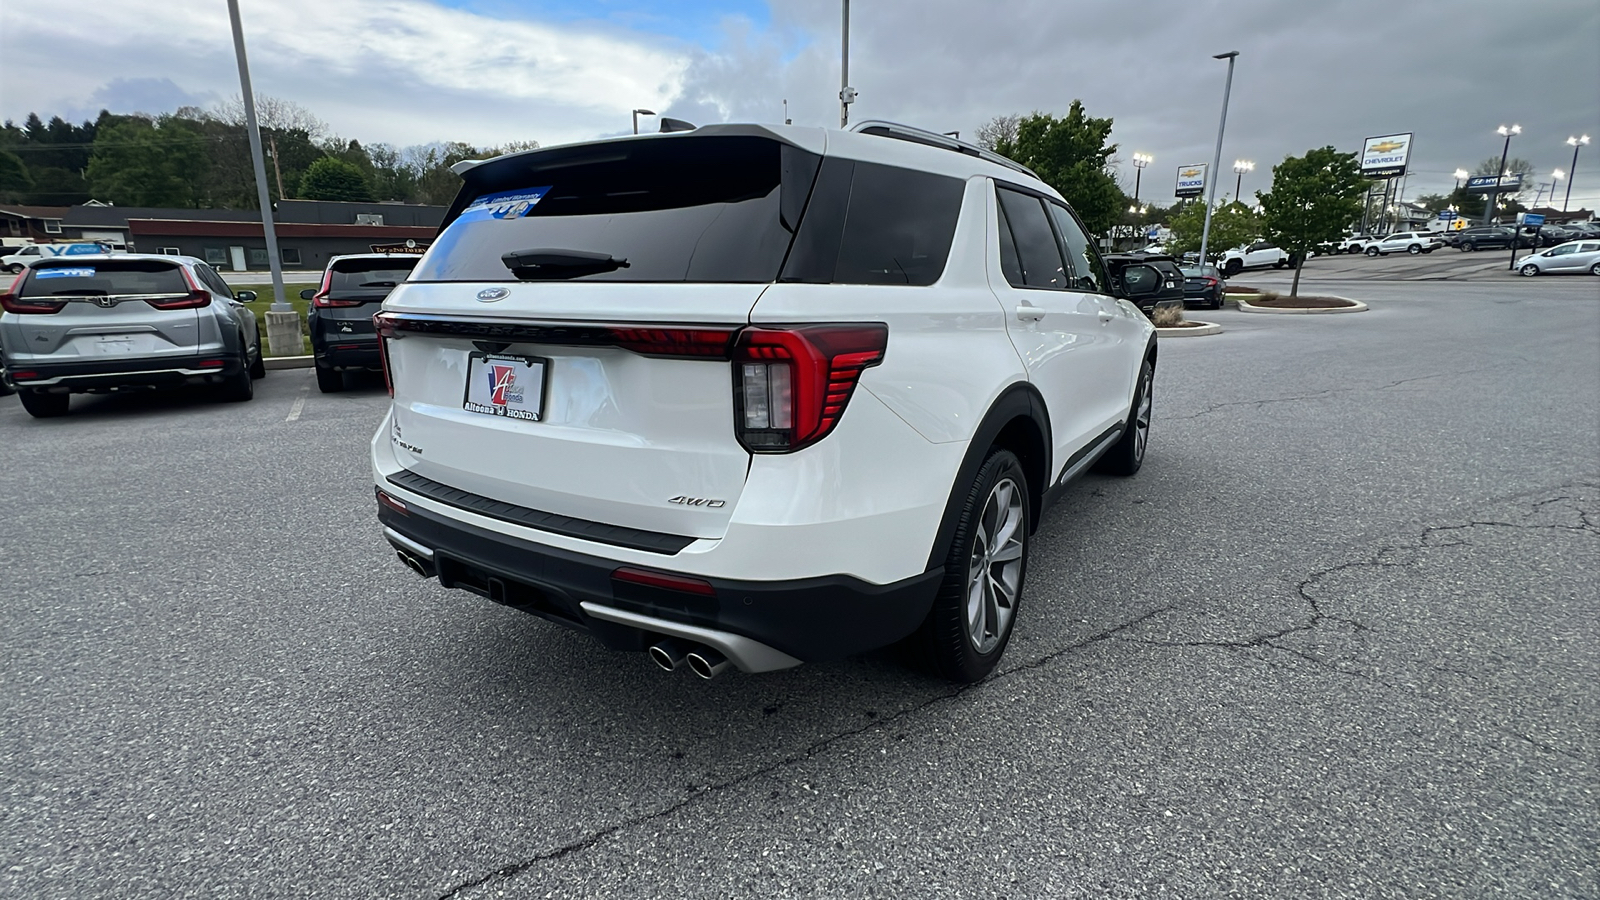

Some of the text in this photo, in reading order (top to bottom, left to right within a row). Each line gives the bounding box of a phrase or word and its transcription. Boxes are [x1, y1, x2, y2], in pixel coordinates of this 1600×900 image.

[1365, 156, 1403, 165] CHEVROLET
[464, 402, 539, 421] Altoona HONDA
[667, 495, 726, 508] 4WD
